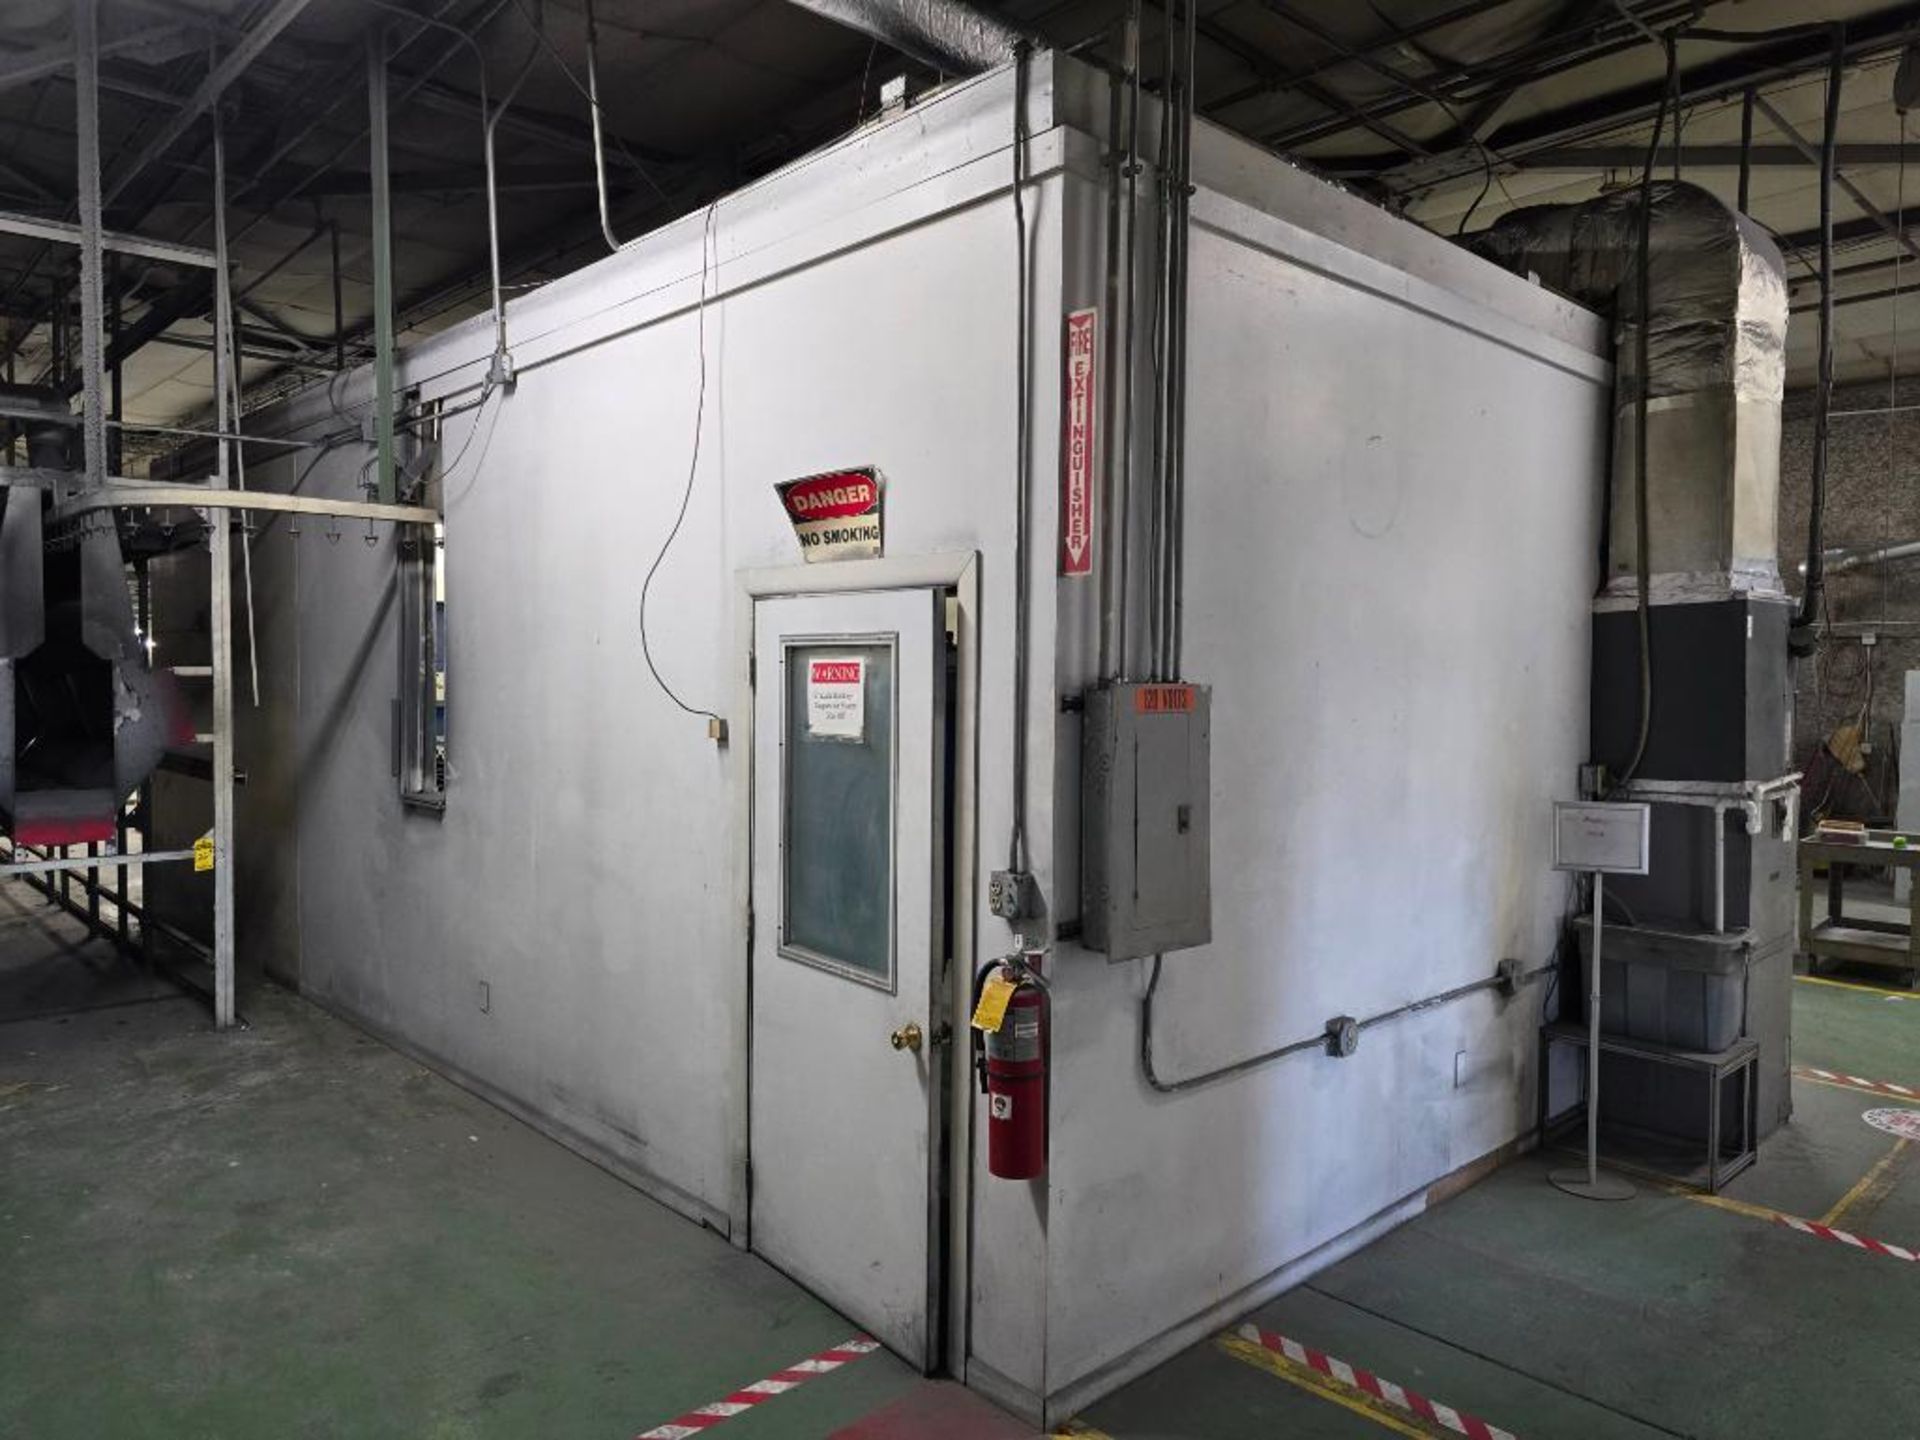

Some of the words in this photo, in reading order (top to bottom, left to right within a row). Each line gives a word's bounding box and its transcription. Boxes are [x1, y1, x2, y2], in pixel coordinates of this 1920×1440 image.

[1071, 361, 1084, 550] EXTINGUISHER
[792, 484, 870, 512] DANGER
[799, 532, 820, 547] NO
[823, 526, 880, 545] SMOKING
[812, 665, 860, 681] WARNING
[1162, 687, 1187, 709] VOLTS
